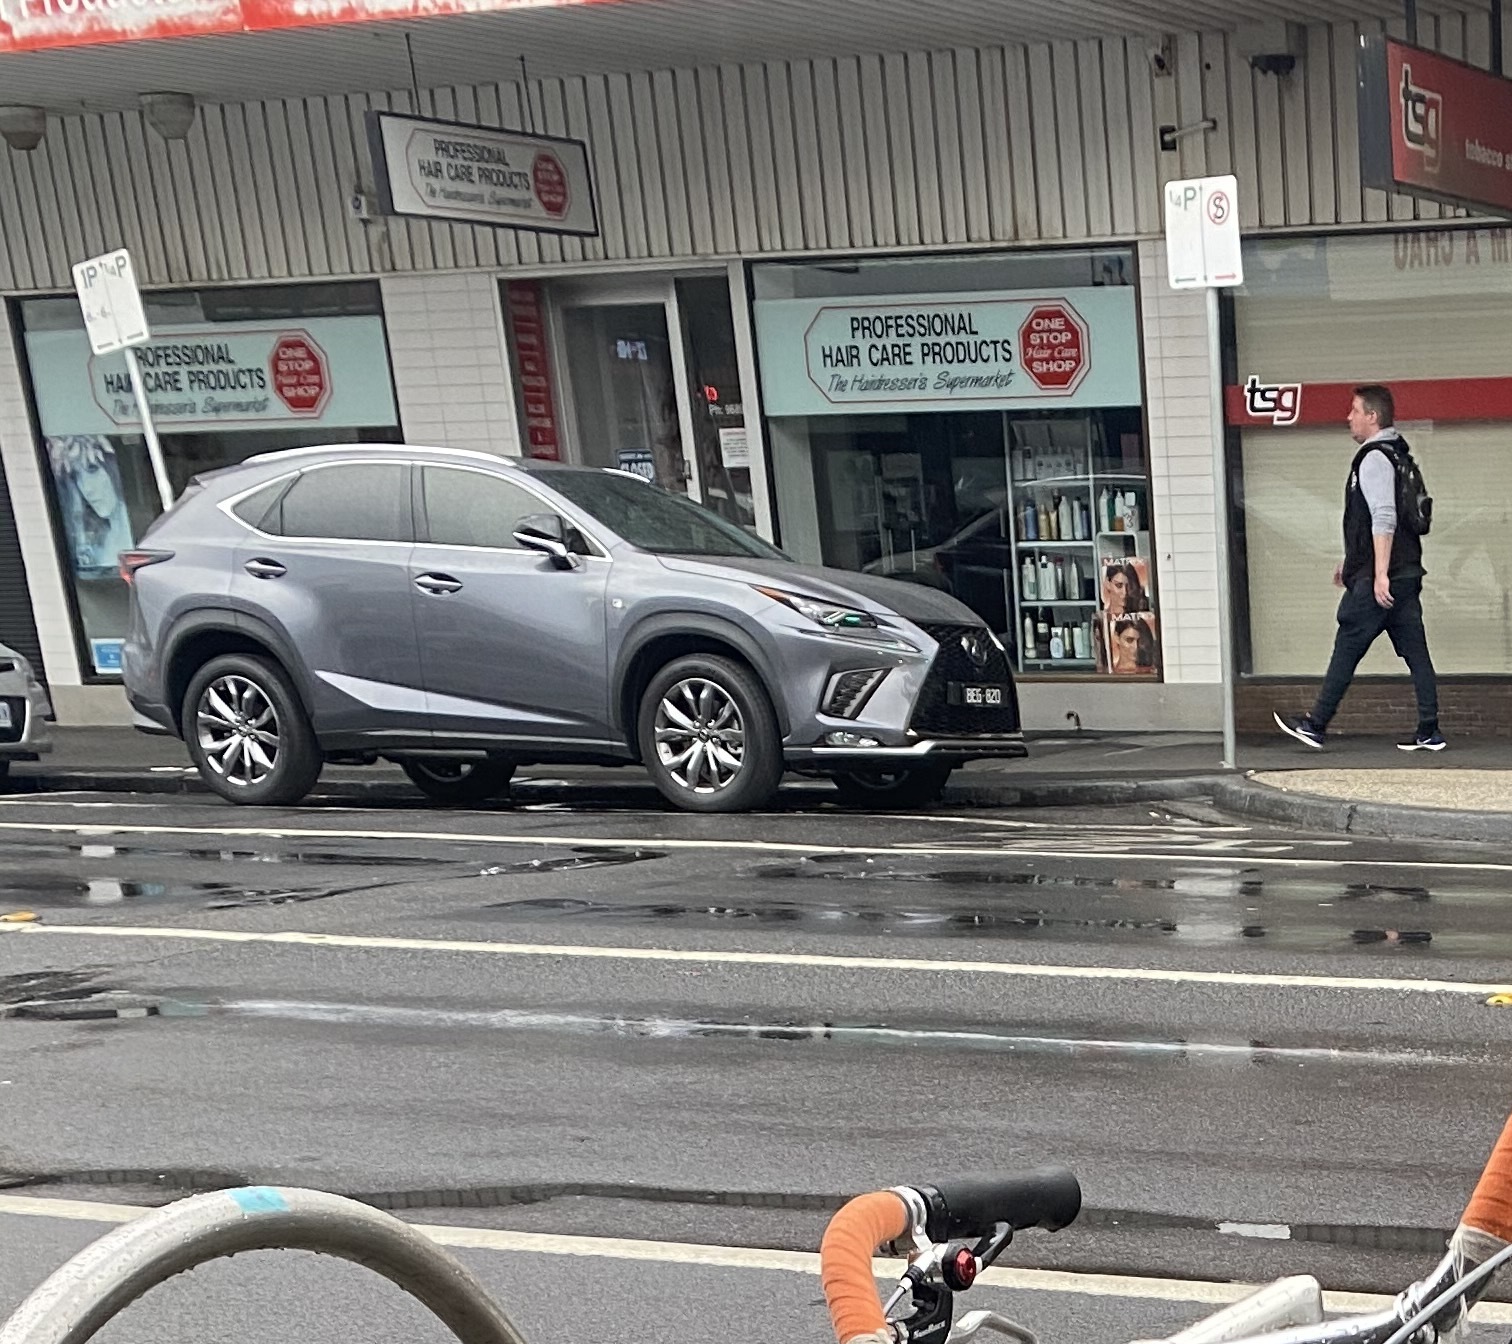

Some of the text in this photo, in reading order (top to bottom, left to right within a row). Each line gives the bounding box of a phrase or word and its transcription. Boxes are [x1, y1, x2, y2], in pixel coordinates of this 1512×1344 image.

[1400, 63, 1442, 174] tsg
[433, 138, 510, 167] PROFESSIONAL
[418, 159, 444, 180] HAIR
[447, 163, 475, 184] CARE
[477, 166, 531, 191] PRODUCTS
[850, 313, 979, 339] PROFESSIONAL
[1031, 317, 1066, 331] ONE
[1029, 332, 1072, 345] STOP
[135, 343, 236, 367] ROFESSIONAL
[821, 339, 1012, 368] HAIR CARE PRODUCTS
[1031, 360, 1076, 373] SHOP
[104, 367, 267, 394] HAI CARE PRODUCTS
[827, 374, 848, 393] The
[933, 370, 1014, 394] Supermarket
[1244, 375, 1301, 425] tsg
